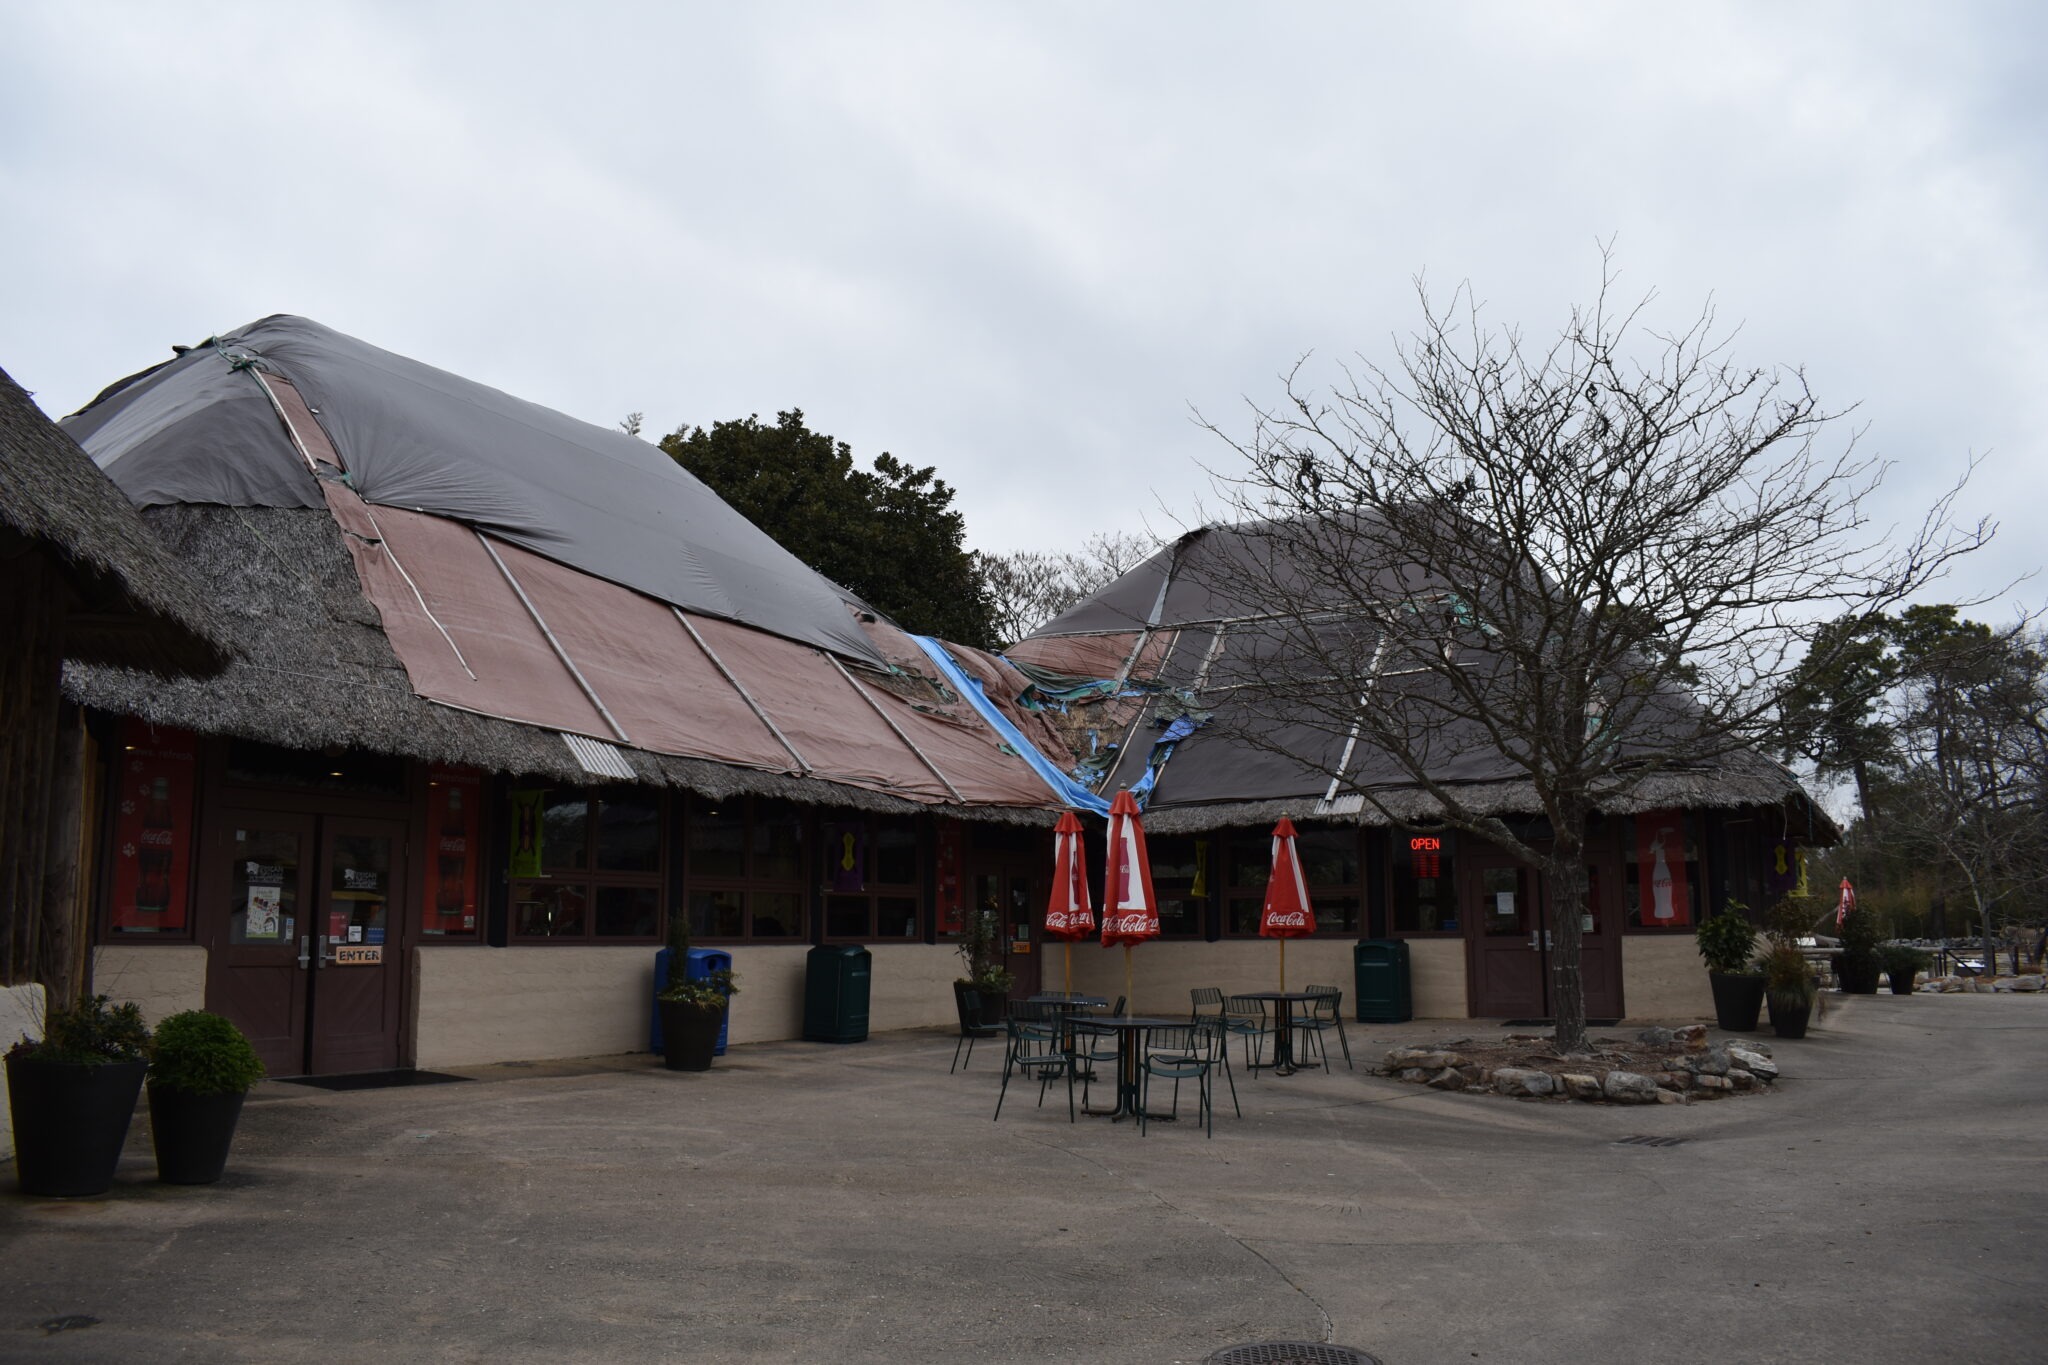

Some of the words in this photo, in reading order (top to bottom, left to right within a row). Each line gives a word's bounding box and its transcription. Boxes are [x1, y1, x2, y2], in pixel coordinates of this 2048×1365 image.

[1410, 837, 1440, 850] OPEN
[1267, 911, 1305, 926] Coca-Cola
[340, 951, 379, 961] ENTER
